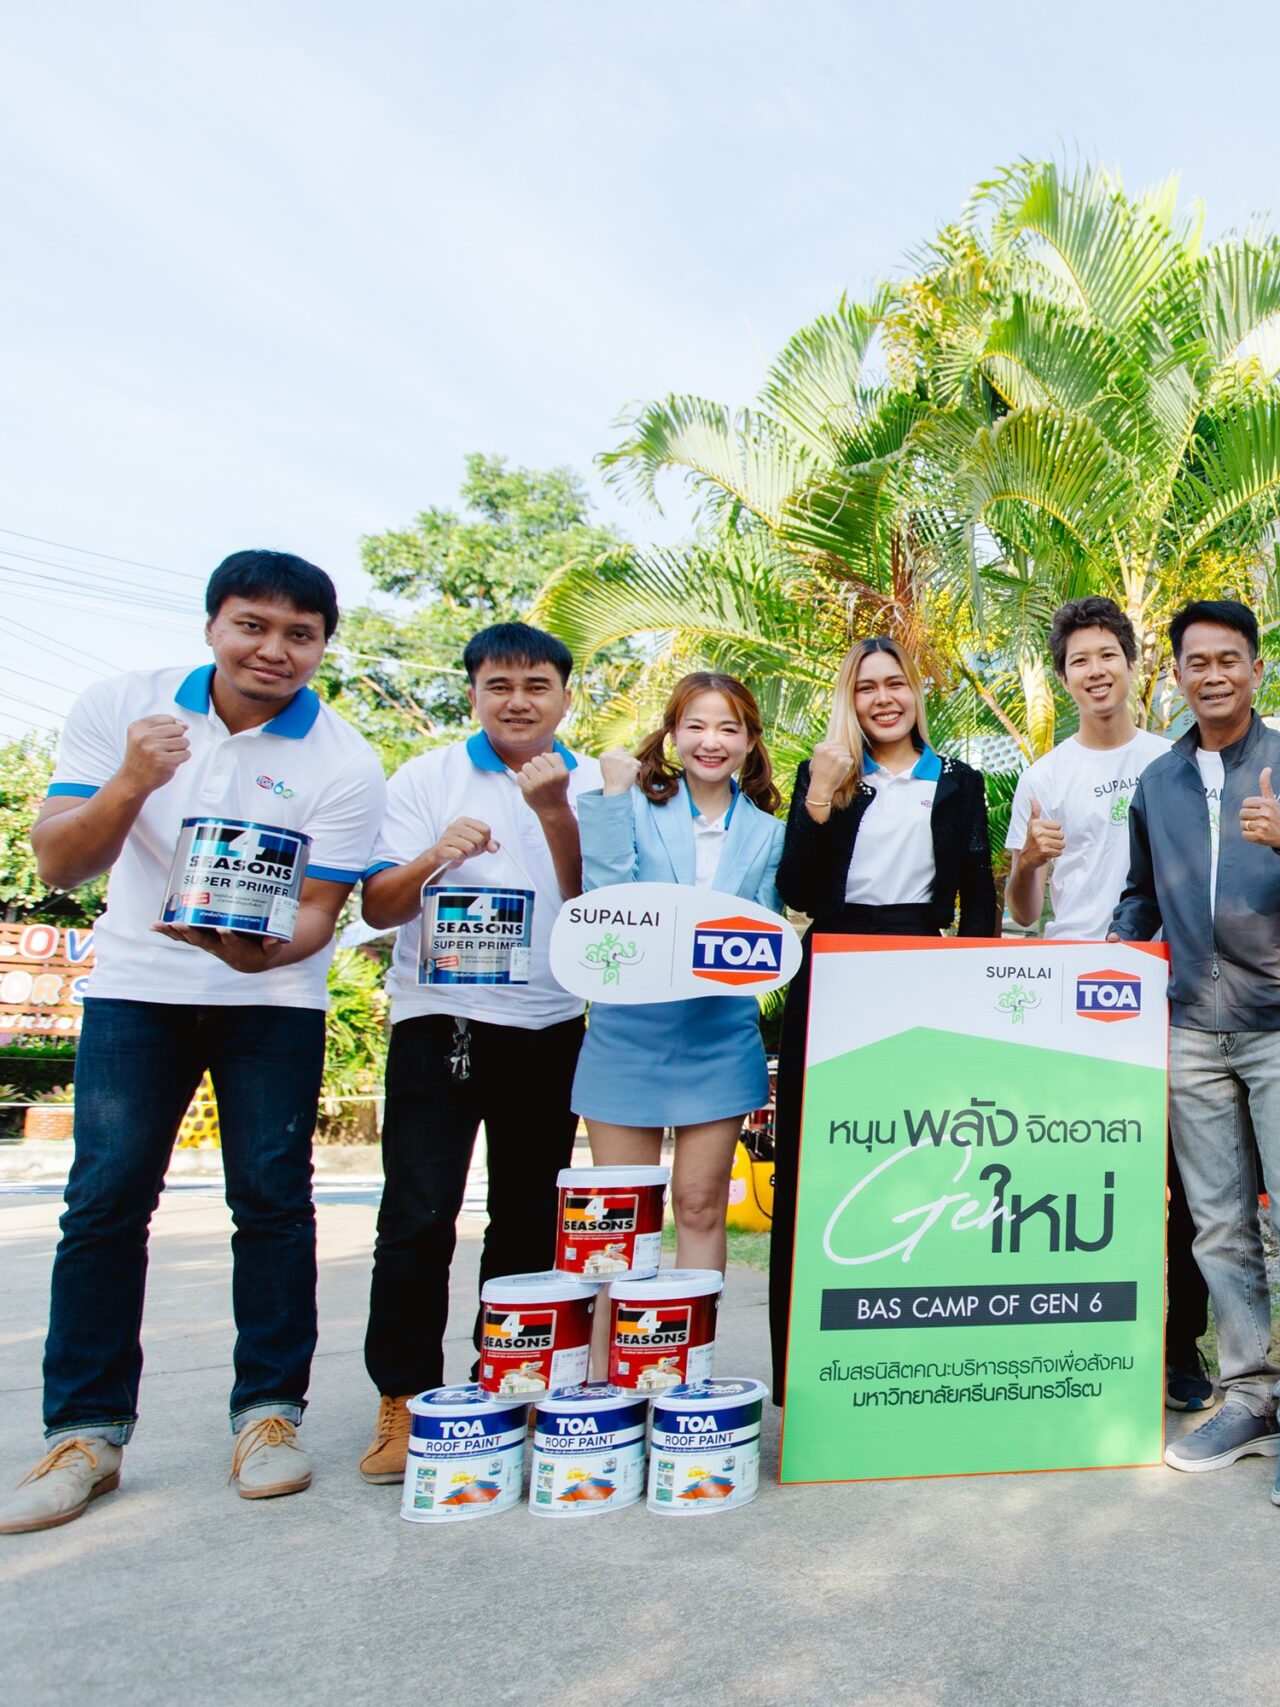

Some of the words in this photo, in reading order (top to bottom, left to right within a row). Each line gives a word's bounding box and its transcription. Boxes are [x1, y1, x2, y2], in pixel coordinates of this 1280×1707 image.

[1094, 777, 1140, 797] SUPALA
[237, 880, 289, 896] PRIMER
[569, 908, 660, 927] SUPALAI
[436, 922, 523, 935] SEASONS
[433, 940, 474, 950] SUPER
[697, 935, 777, 967] TOA
[986, 965, 1052, 980] SUPALAI
[1078, 984, 1139, 1008] TOA
[829, 1119, 896, 1153] หนุน
[903, 1097, 1019, 1147] พลัง
[1026, 1114, 1142, 1143] จิตอาสา
[822, 1135, 1016, 1265] Gen
[979, 1163, 1115, 1254] ใหม่
[564, 1220, 634, 1231] SEASONS
[856, 1298, 902, 1320] BAS
[912, 1296, 980, 1319] CAMP
[988, 1294, 1020, 1317] OF
[1030, 1292, 1079, 1315] GEN
[1089, 1292, 1103, 1313] 6
[484, 1336, 551, 1348] SEASONS
[617, 1332, 687, 1344] SEASONS
[439, 1420, 485, 1439] TOA
[556, 1416, 599, 1435] TOA
[676, 1415, 718, 1433] TOA
[426, 1441, 461, 1452] ROOF
[464, 1436, 502, 1450] PAINT
[546, 1437, 575, 1448] ROOF
[579, 1433, 616, 1447] PAINT
[665, 1435, 696, 1446] ROOF
[699, 1432, 734, 1445] PAINT
